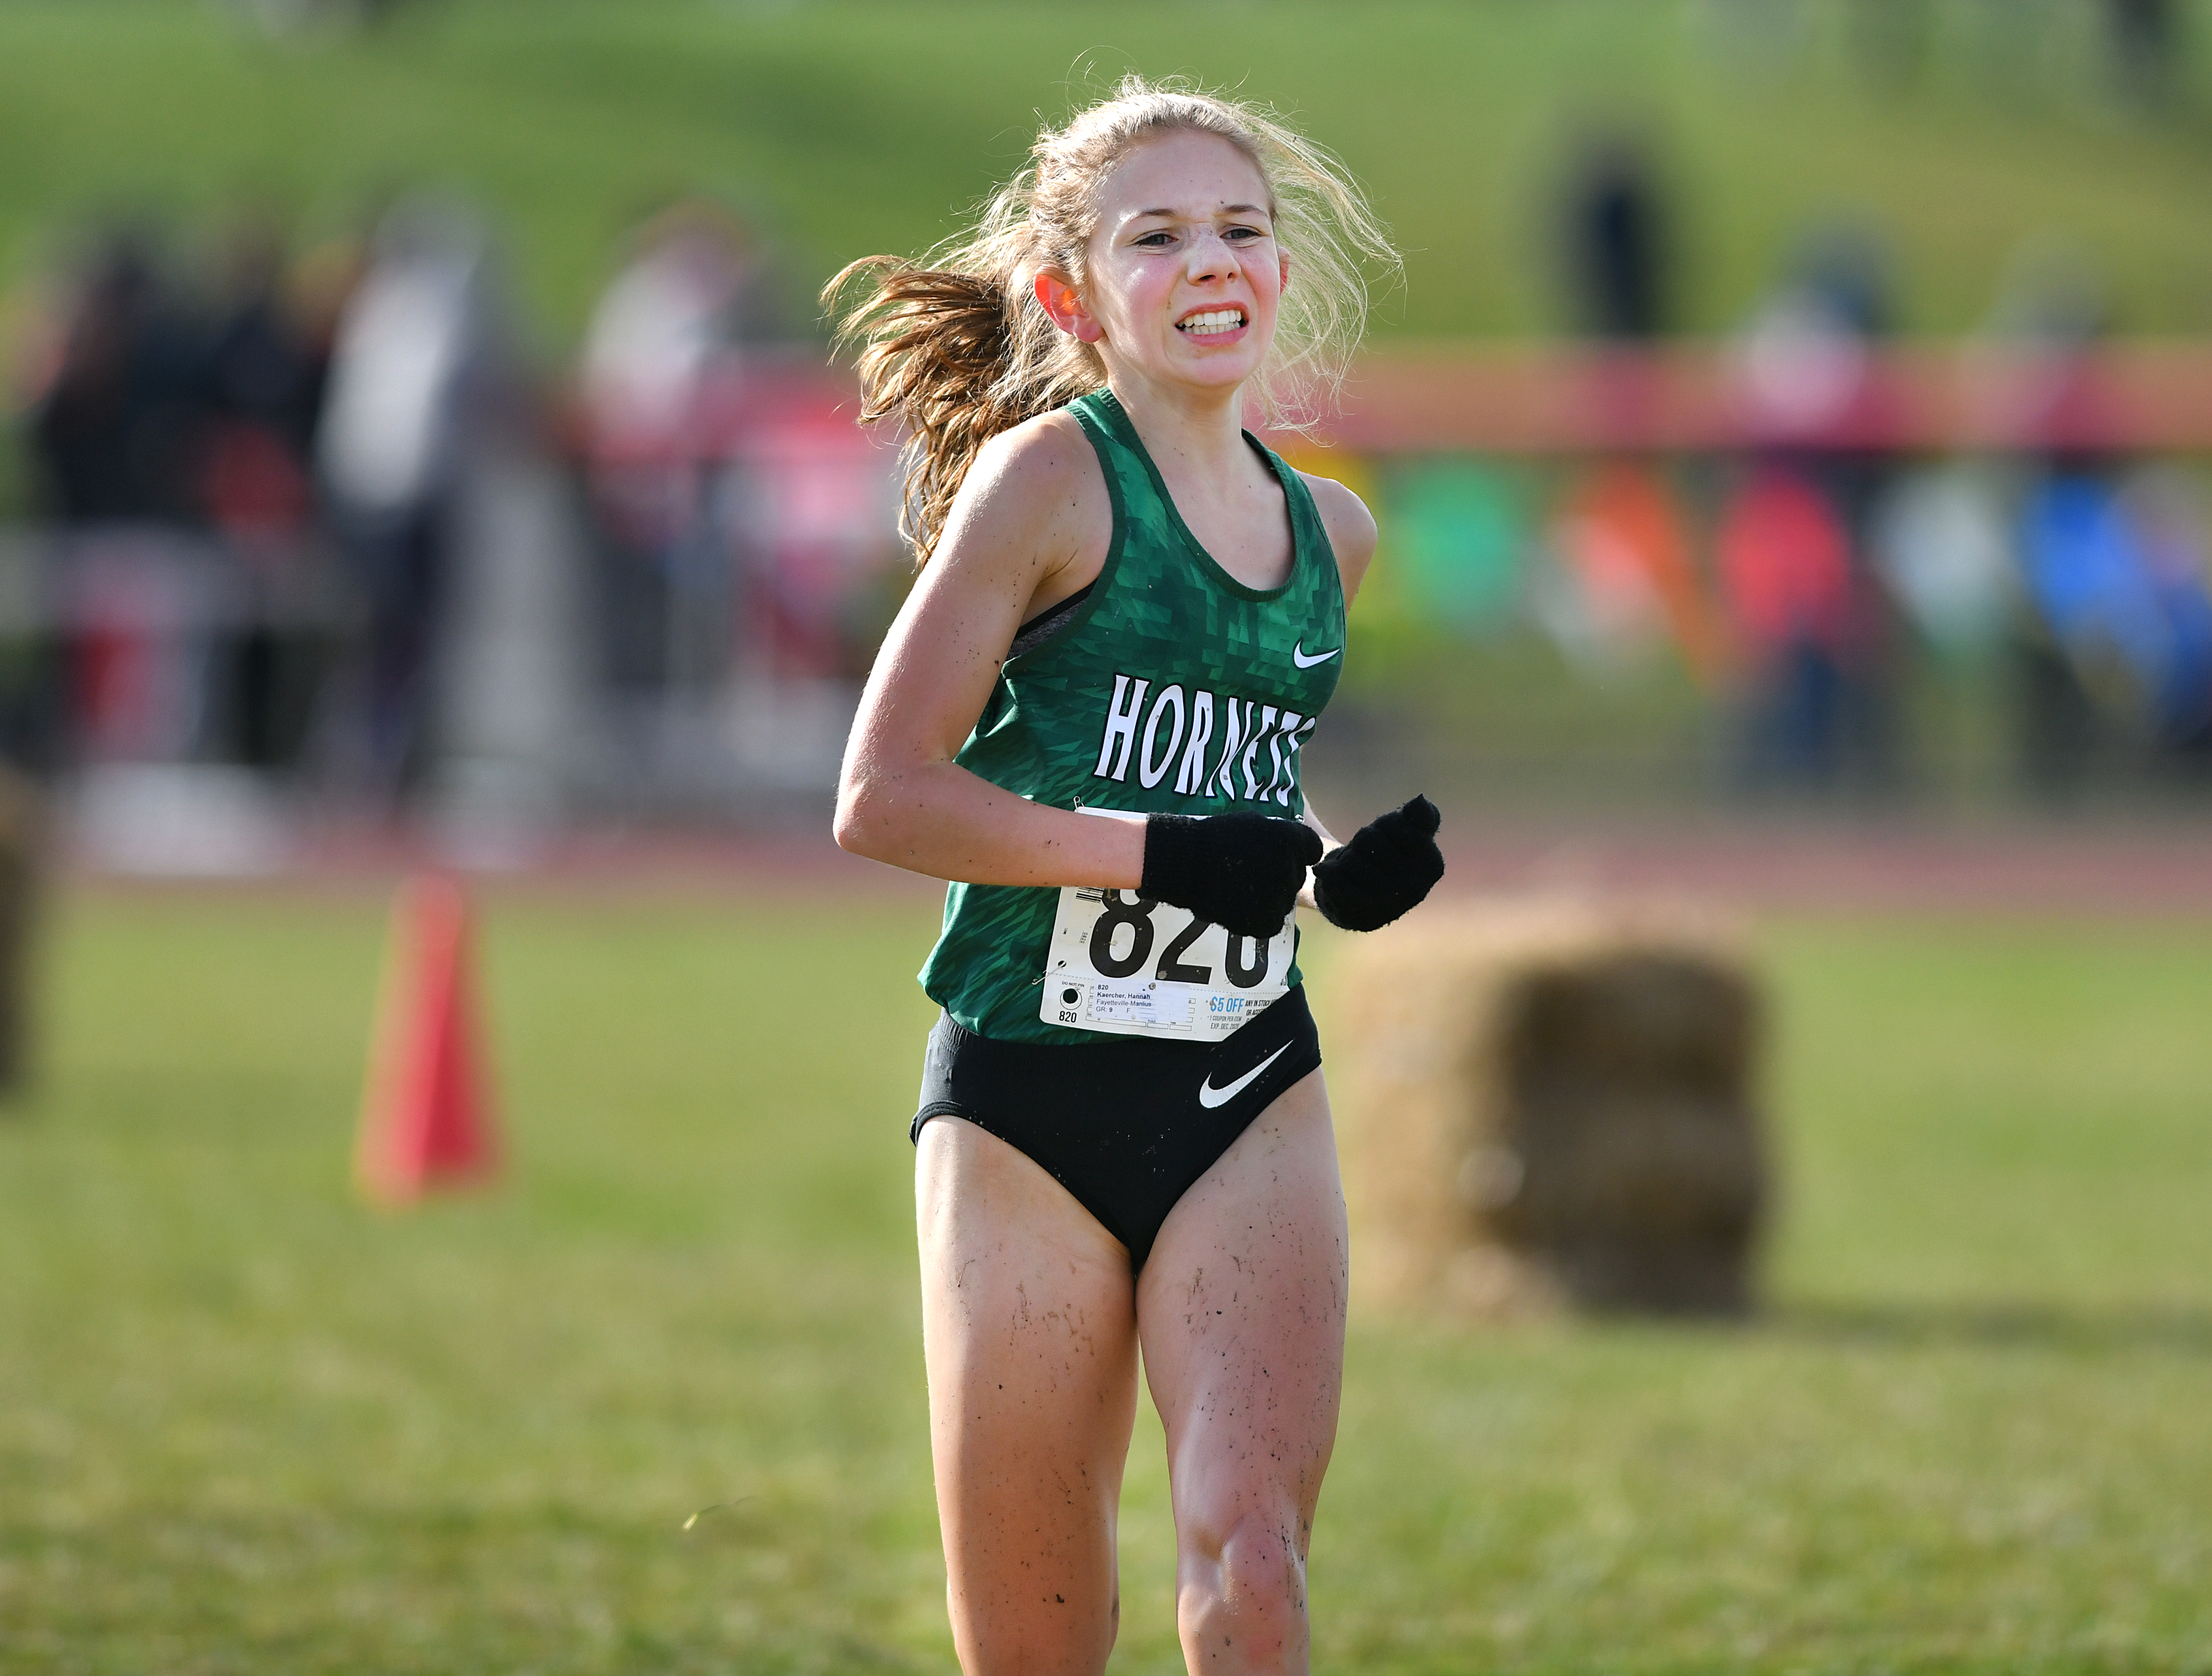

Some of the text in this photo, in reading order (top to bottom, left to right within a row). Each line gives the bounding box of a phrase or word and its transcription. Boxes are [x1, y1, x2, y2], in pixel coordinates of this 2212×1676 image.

[1093, 672, 1316, 807] HORNETS
[1097, 999, 1152, 1007] Fayetteville-Manlius
[1210, 996, 1225, 1012] $5
[1226, 997, 1245, 1013] OFF
[1059, 1011, 1077, 1023] 820
